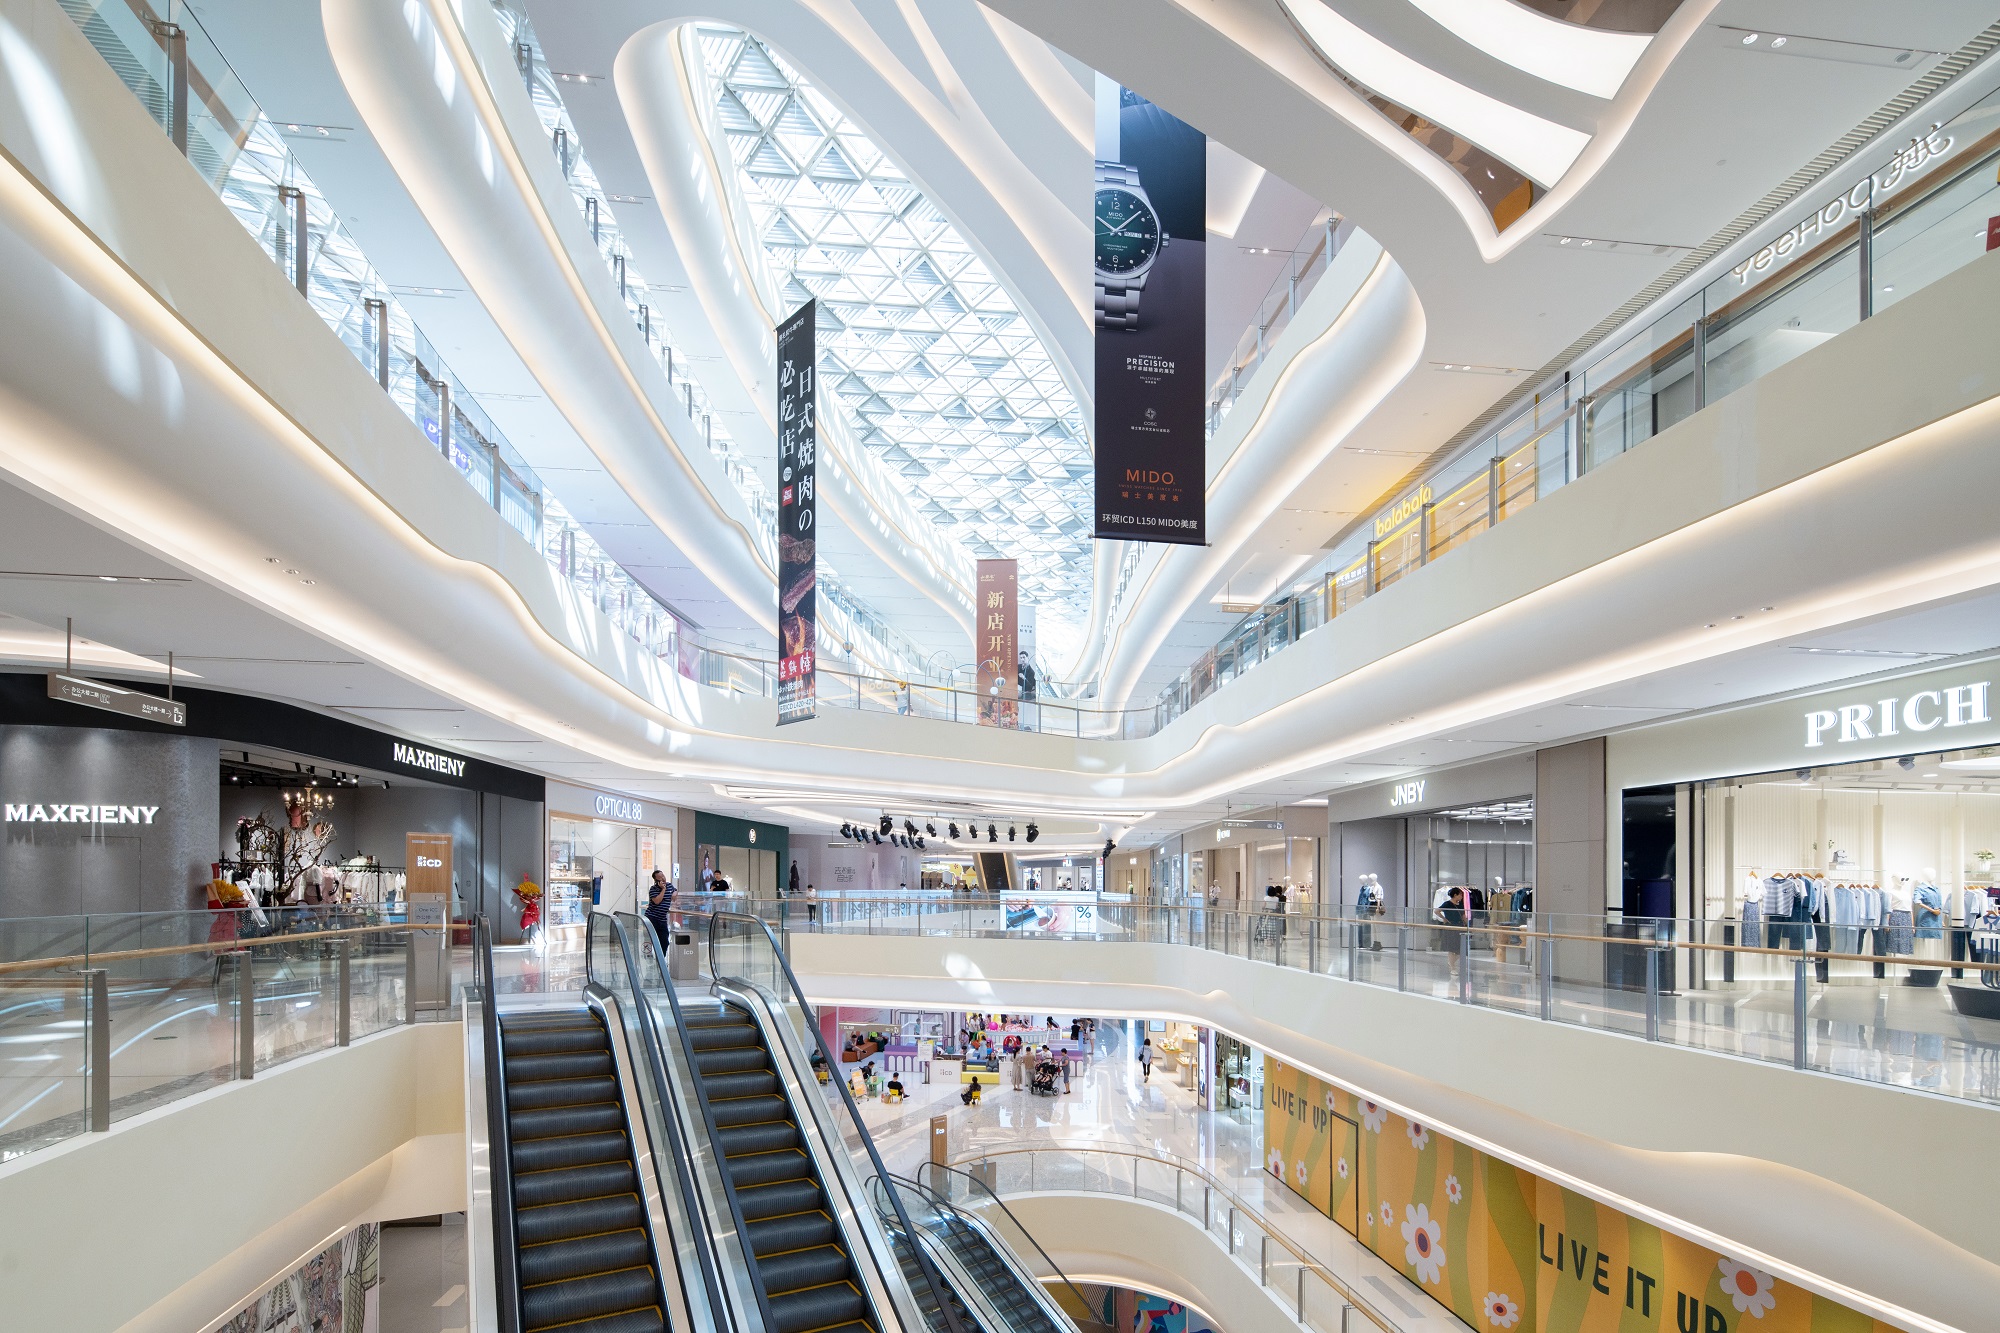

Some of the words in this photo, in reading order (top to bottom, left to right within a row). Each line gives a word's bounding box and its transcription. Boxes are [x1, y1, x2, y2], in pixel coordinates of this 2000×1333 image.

[1126, 357, 1175, 369] PRECISION
[780, 359, 796, 459] 必吃店
[1126, 468, 1174, 485] MIDO
[1102, 513, 1134, 524] 环贸ICD
[1136, 516, 1157, 527] L150
[1158, 518, 1198, 530] MIDO美度
[1376, 484, 1432, 537] balabala
[987, 590, 1005, 673] 新店开业
[173, 712, 184, 724] L2
[1804, 681, 1991, 747] PRICH
[393, 742, 465, 777] MAXRIENY
[595, 795, 632, 819] OPTICAL
[632, 804, 642, 821] 88
[1390, 780, 1426, 807] JNBY
[5, 803, 160, 824] MAXRIENY
[1271, 1083, 1294, 1116] LIVE
[1298, 1097, 1308, 1123] IT
[1313, 1105, 1327, 1133] UP
[1539, 1222, 1609, 1295] LIVE
[1626, 1266, 1656, 1318] IT
[1677, 1291, 1728, 1333] UP
